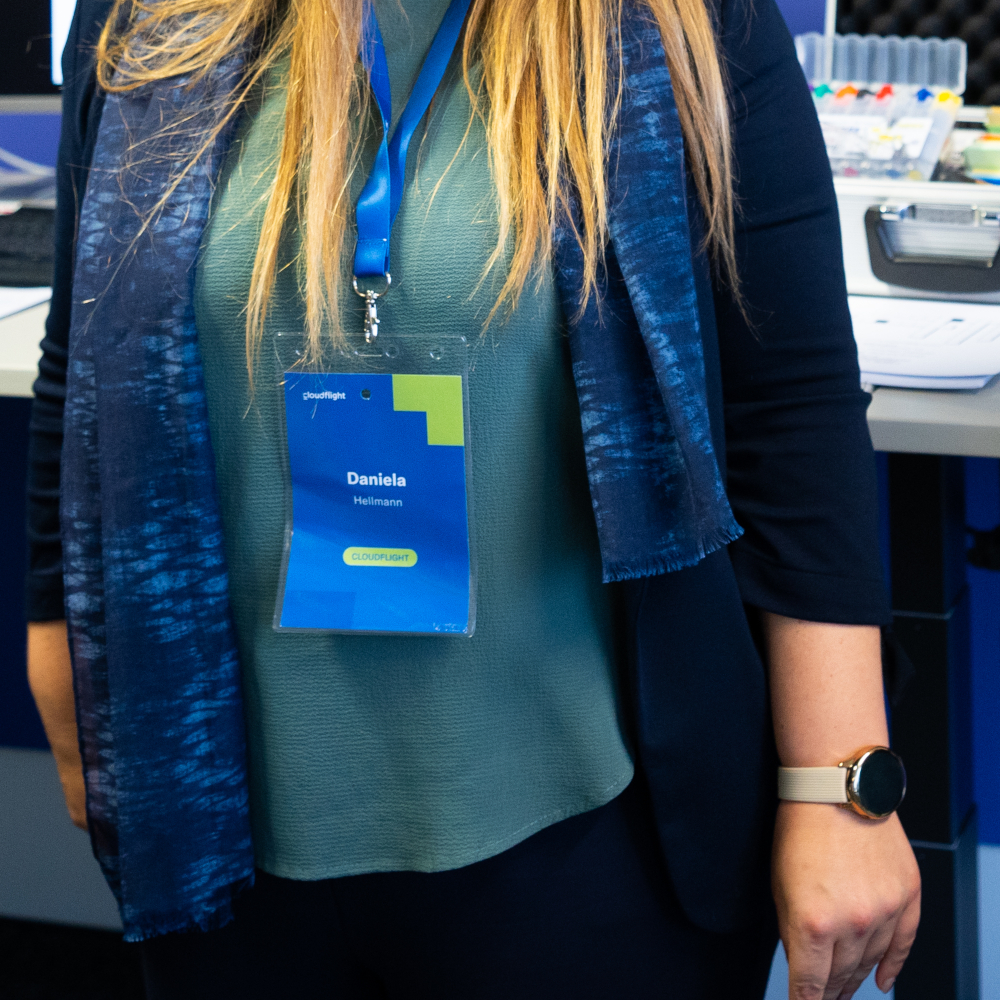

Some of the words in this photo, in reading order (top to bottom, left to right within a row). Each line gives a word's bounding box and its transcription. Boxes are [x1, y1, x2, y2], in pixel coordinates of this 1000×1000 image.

[303, 391, 346, 401] cloudflight
[347, 471, 407, 487] Daniela
[353, 495, 403, 507] Hellmann
[351, 552, 410, 562] CLOUDFLIGHT
